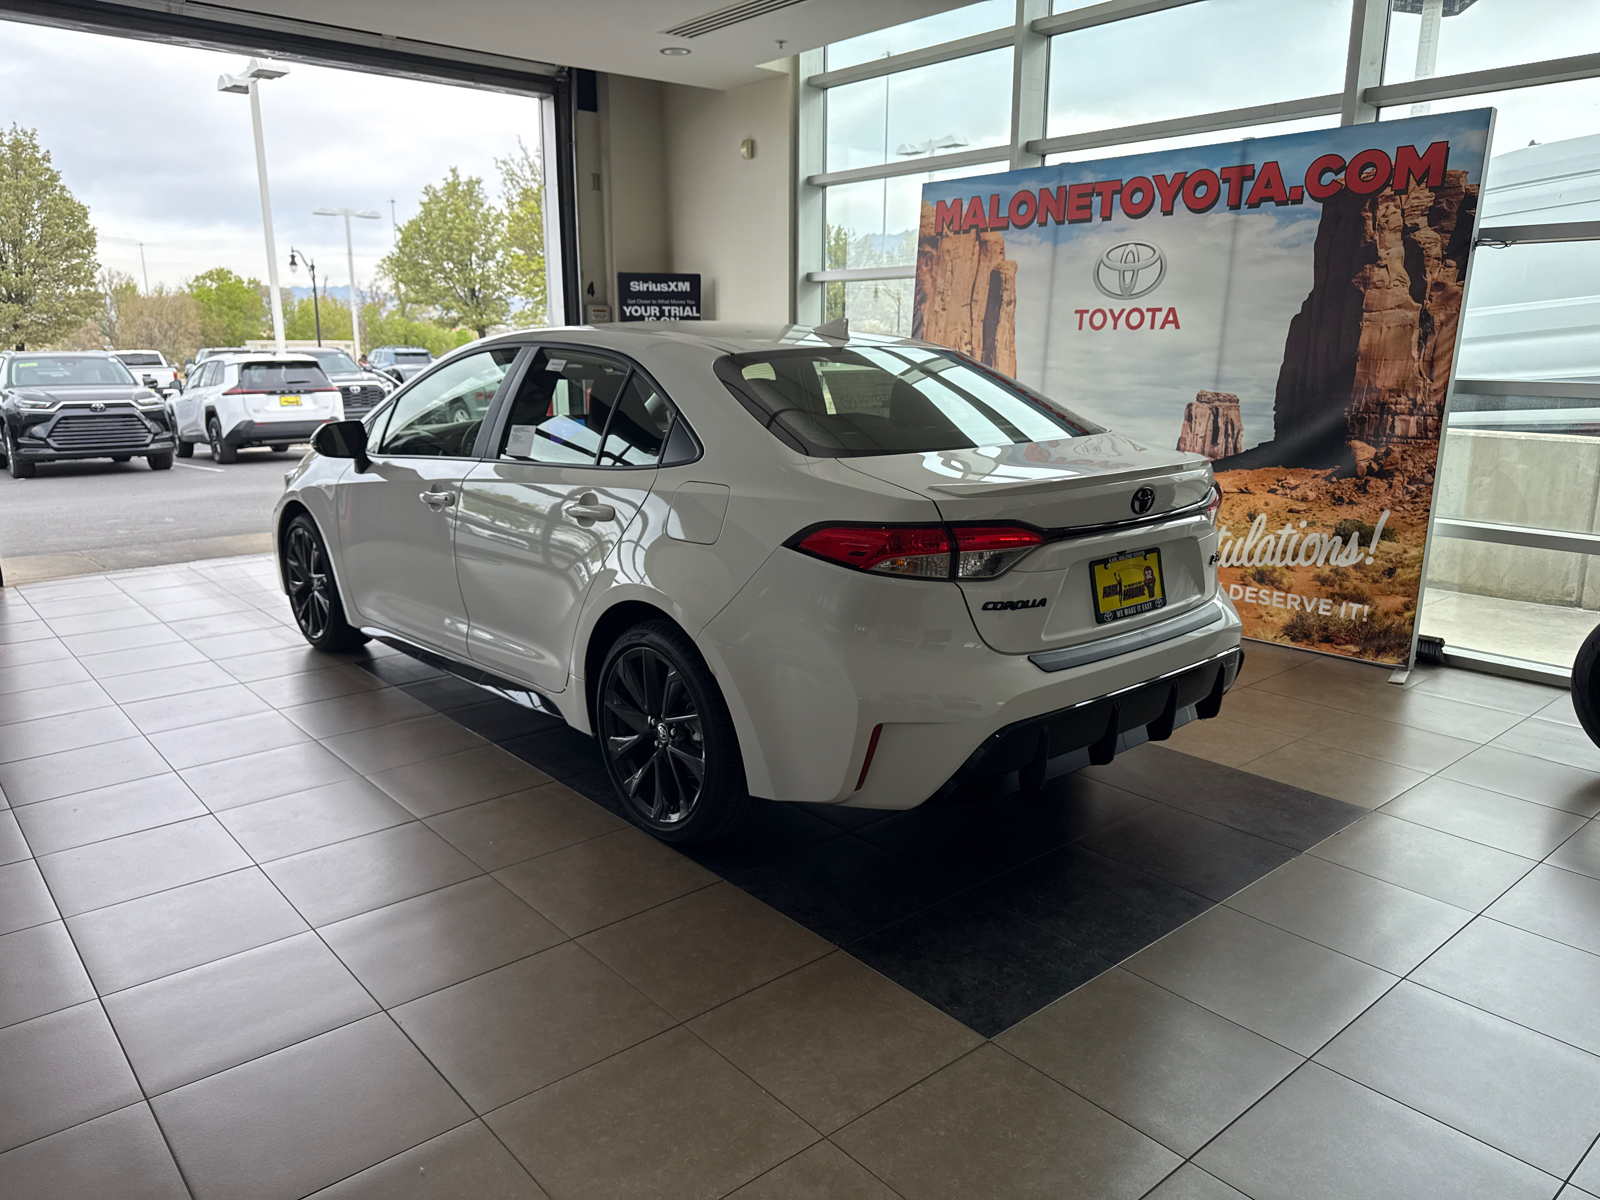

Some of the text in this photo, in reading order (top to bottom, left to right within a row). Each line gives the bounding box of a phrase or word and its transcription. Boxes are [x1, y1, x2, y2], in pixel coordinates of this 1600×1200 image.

[935, 141, 1450, 234] MALONETOYOTA.COM
[587, 281, 595, 297] 4
[629, 281, 691, 292] SiriusXM
[622, 305, 700, 317] YOUR TRIAL
[1074, 306, 1181, 331] TOYOTA
[1217, 509, 1390, 568] tulations!
[1145, 570, 1152, 579] 32
[981, 598, 1048, 611] COROLLA
[1116, 602, 1152, 618] WE MAKE IT EASY
[1229, 584, 1369, 622] DESERVE IT!
